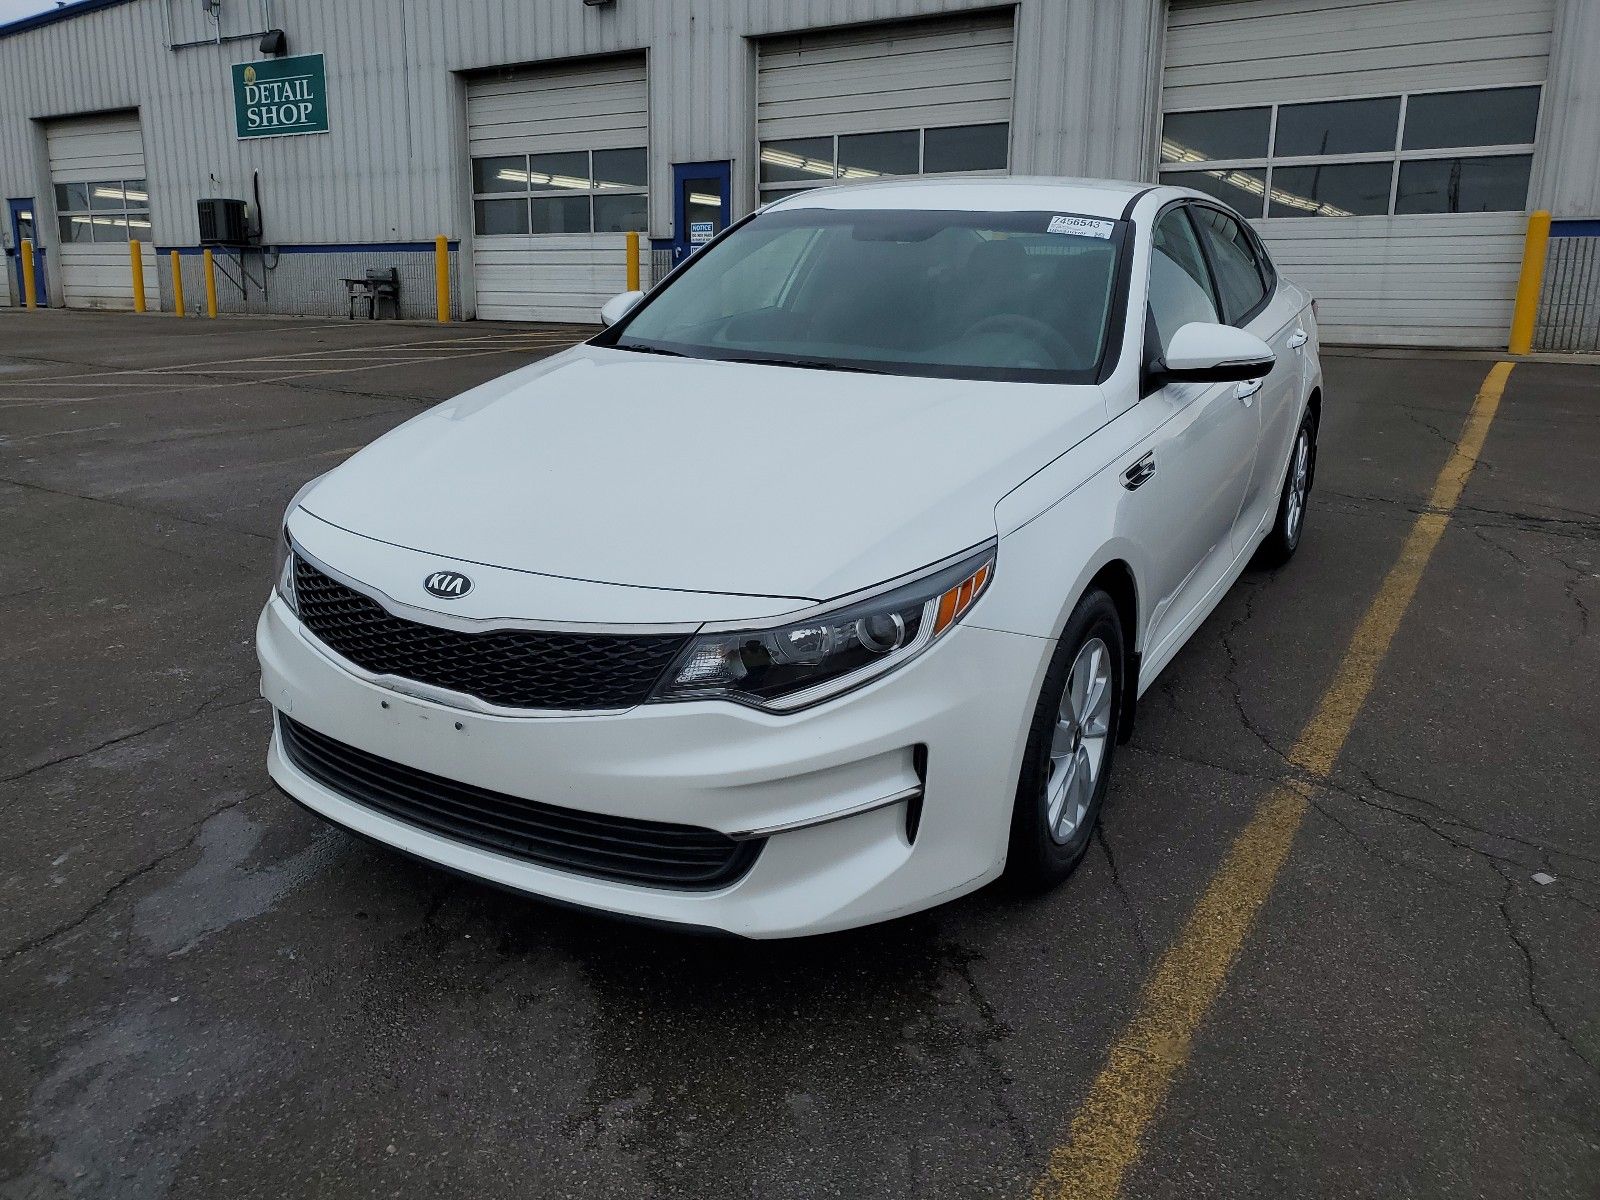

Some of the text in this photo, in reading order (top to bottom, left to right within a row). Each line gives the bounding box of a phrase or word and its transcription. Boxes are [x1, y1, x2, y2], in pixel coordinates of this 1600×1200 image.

[244, 80, 314, 105] DETAIL
[247, 102, 313, 127] SHOP
[1053, 217, 1100, 229] 7456543
[428, 573, 464, 594] KIA
